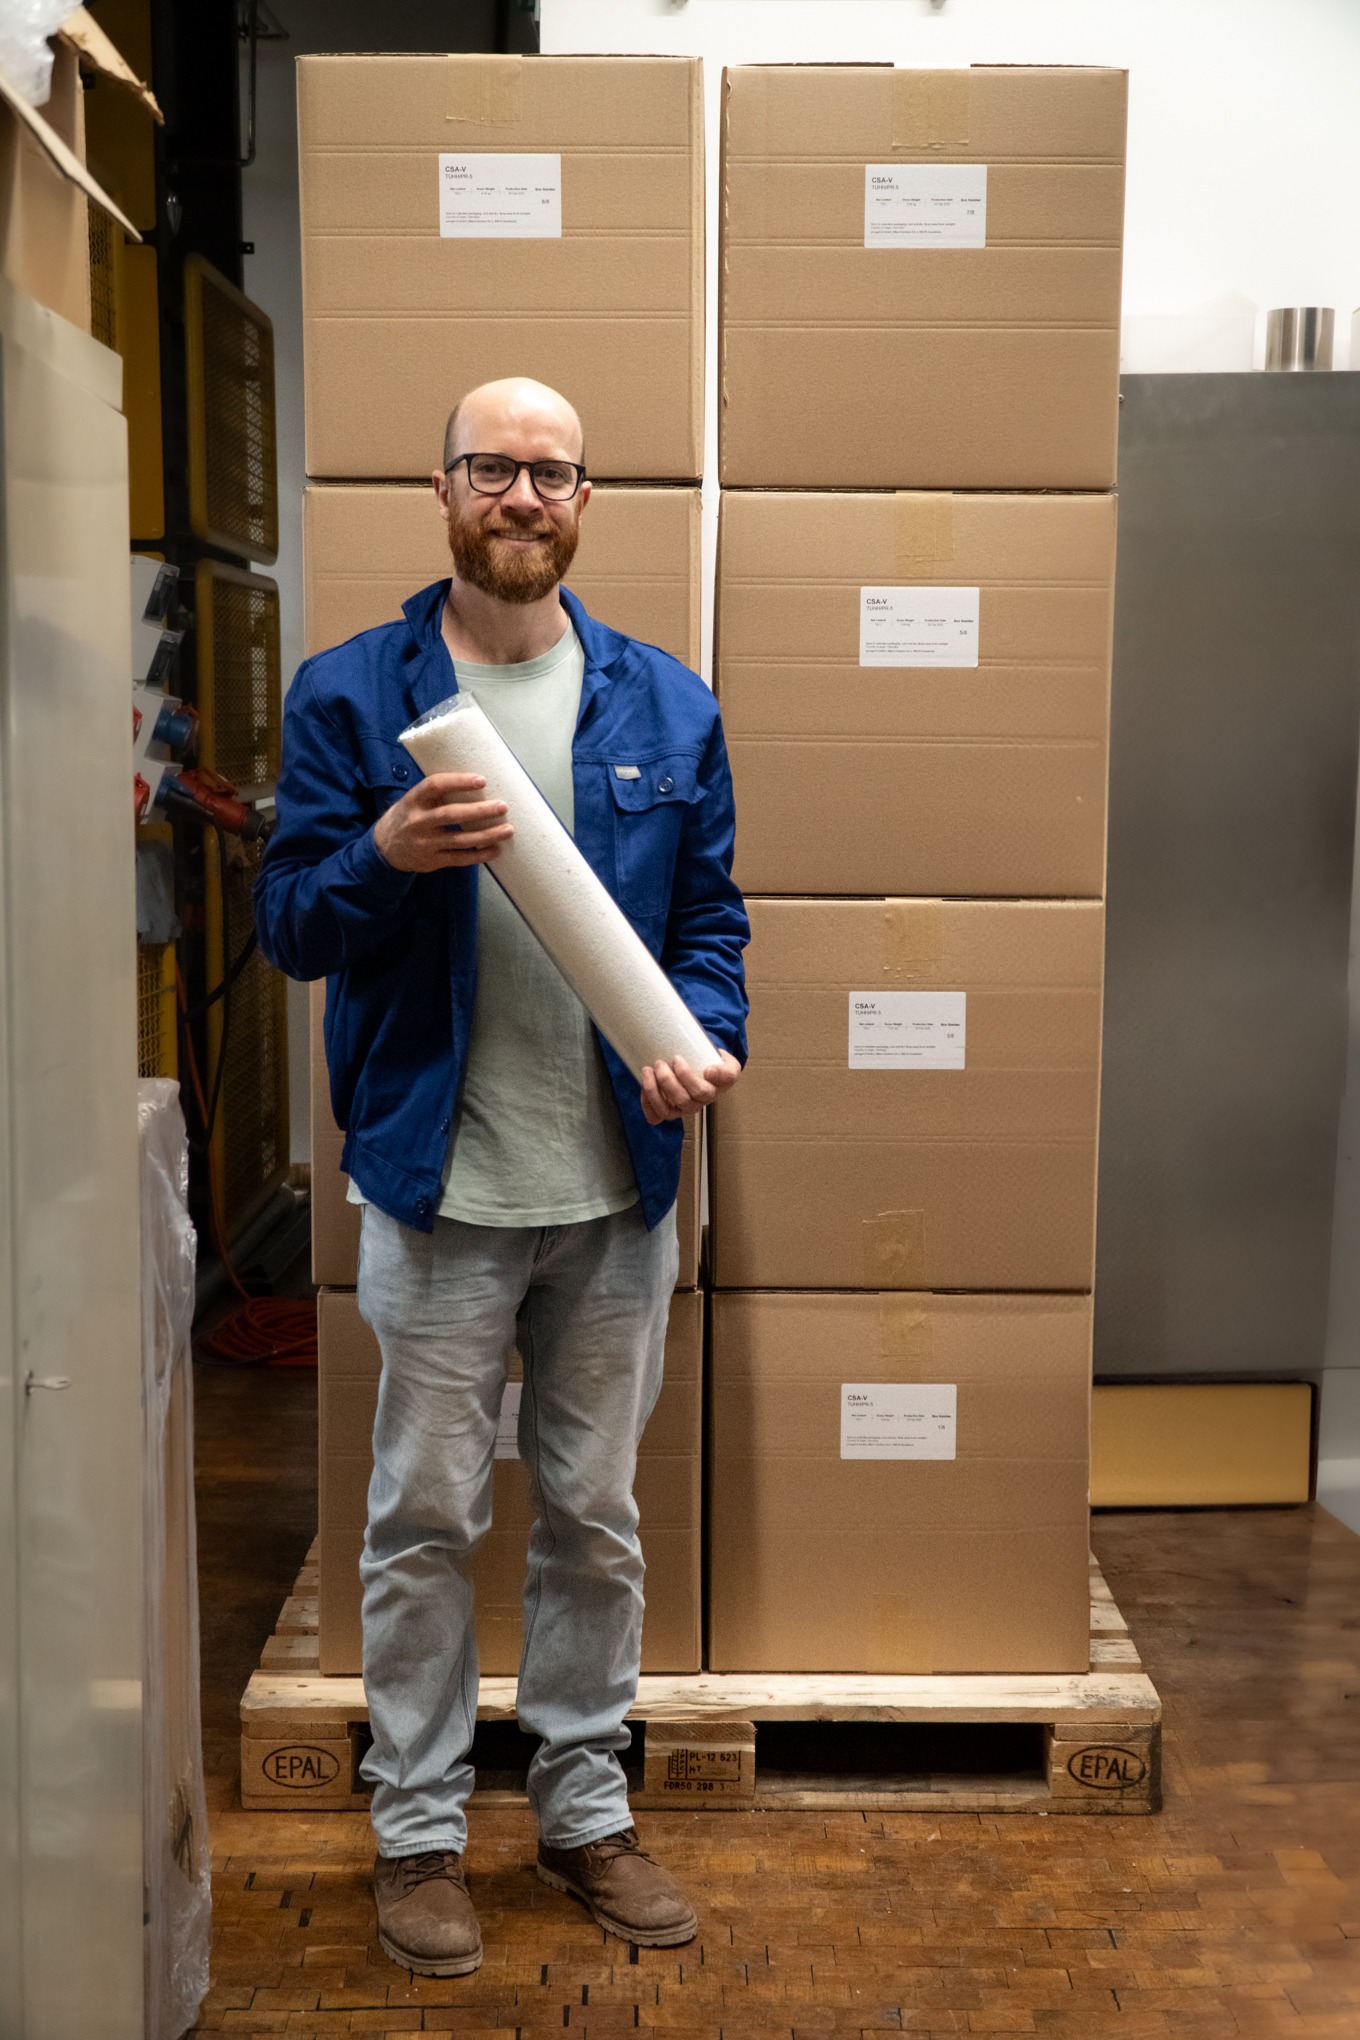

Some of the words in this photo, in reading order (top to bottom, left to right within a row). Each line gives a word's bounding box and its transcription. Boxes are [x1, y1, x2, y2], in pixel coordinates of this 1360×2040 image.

[275, 1755, 330, 1779] EPAL
[689, 1752, 717, 1762] PL-12
[1080, 1754, 1134, 1782] EPAL
